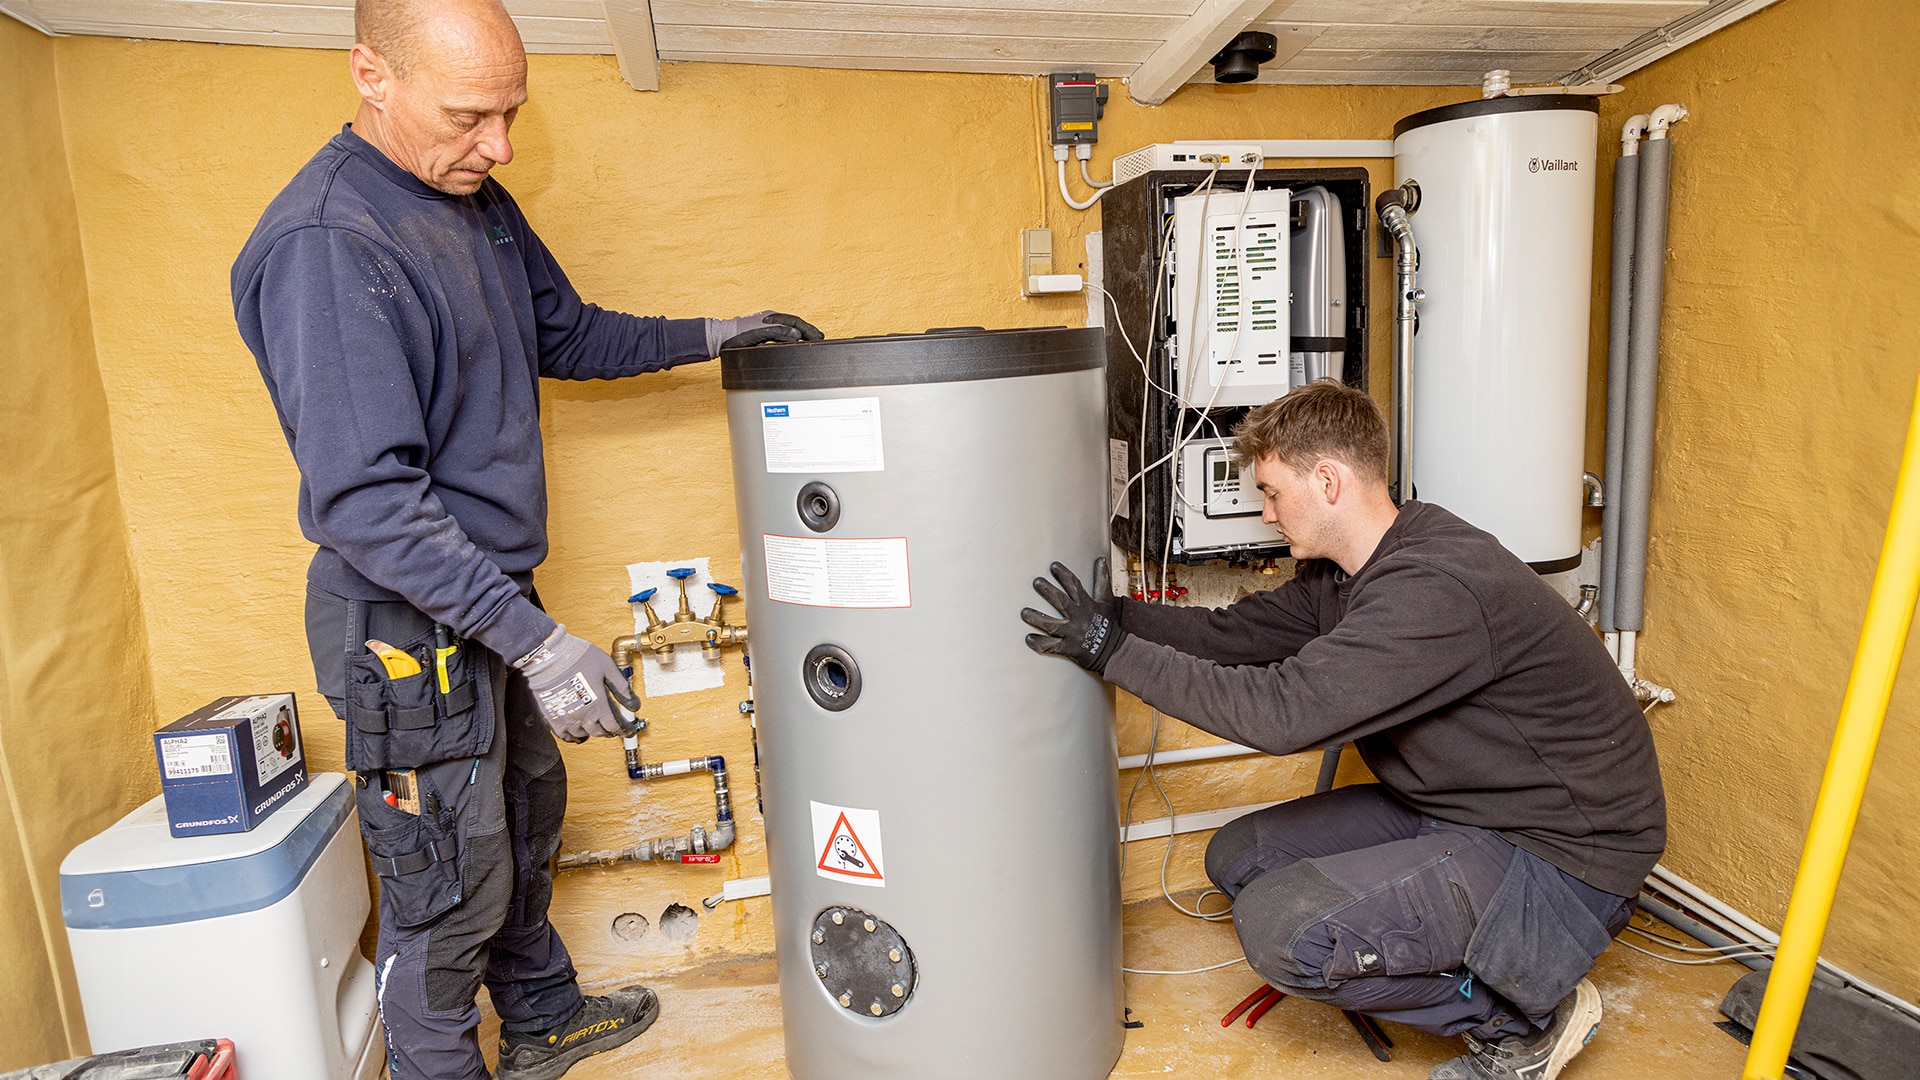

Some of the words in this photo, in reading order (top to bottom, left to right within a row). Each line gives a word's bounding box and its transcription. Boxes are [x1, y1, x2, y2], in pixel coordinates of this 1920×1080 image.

[1629, 128, 1635, 136] R
[1541, 159, 1578, 171] Vaillant
[1089, 617, 1109, 655] ODIN
[167, 767, 199, 775] 99411175
[254, 781, 297, 815] GRUNDFOS
[175, 818, 228, 829] GRUNDFOS
[560, 1018, 620, 1047] AIRTOX
